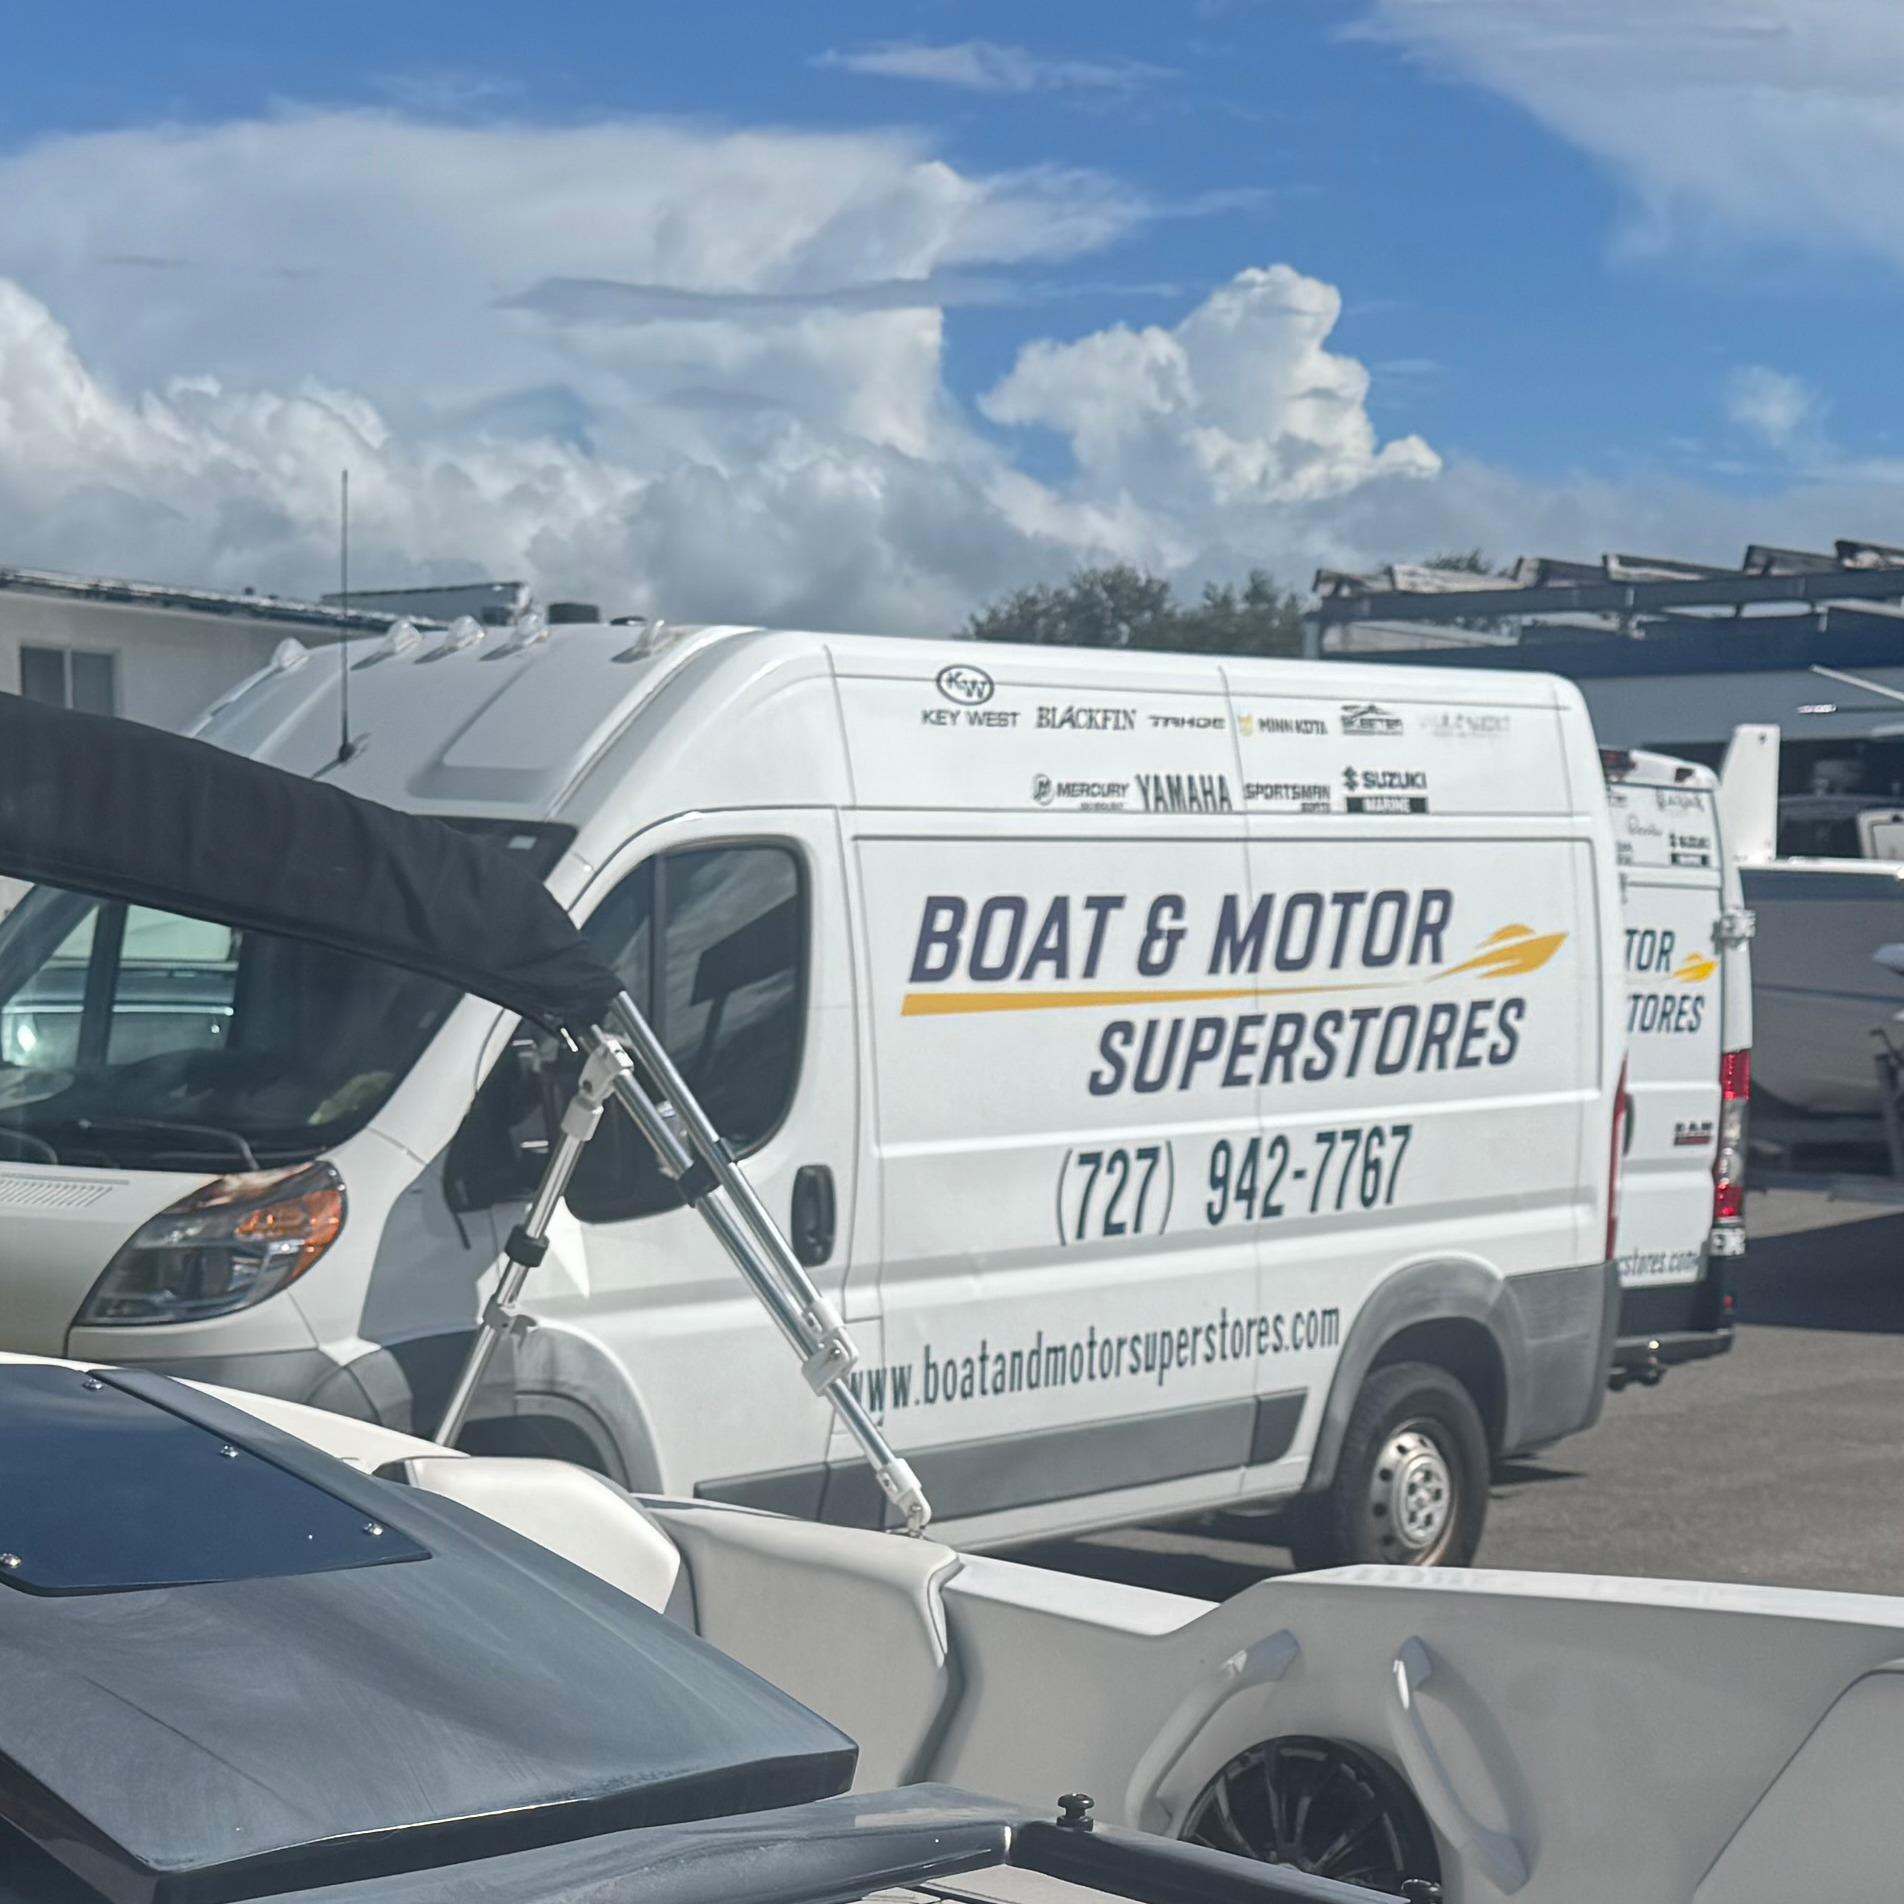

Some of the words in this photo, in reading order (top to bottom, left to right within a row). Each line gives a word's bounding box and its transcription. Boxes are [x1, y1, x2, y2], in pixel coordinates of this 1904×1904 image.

[921, 709, 960, 725] KEY
[967, 711, 1020, 727] WEST
[1035, 704, 1137, 731] BLACKFIN
[1056, 781, 1130, 799] MERCURY
[1134, 773, 1233, 812] YAMAHA
[1244, 782, 1331, 801] SPORTSMAN
[1362, 771, 1427, 789] SUZUKI
[909, 895, 1124, 984] BOAT
[1137, 893, 1186, 976] &
[1207, 888, 1456, 976] MOTOR
[1625, 928, 1675, 972] TOR
[1627, 993, 1705, 1034] TORES
[1087, 997, 1528, 1097] SUPERSTORES
[1056, 1144, 1176, 1247] (727)
[1206, 1123, 1414, 1227] 942-7767
[849, 1305, 1341, 1414] www.boatandmotorsuperstores.com
